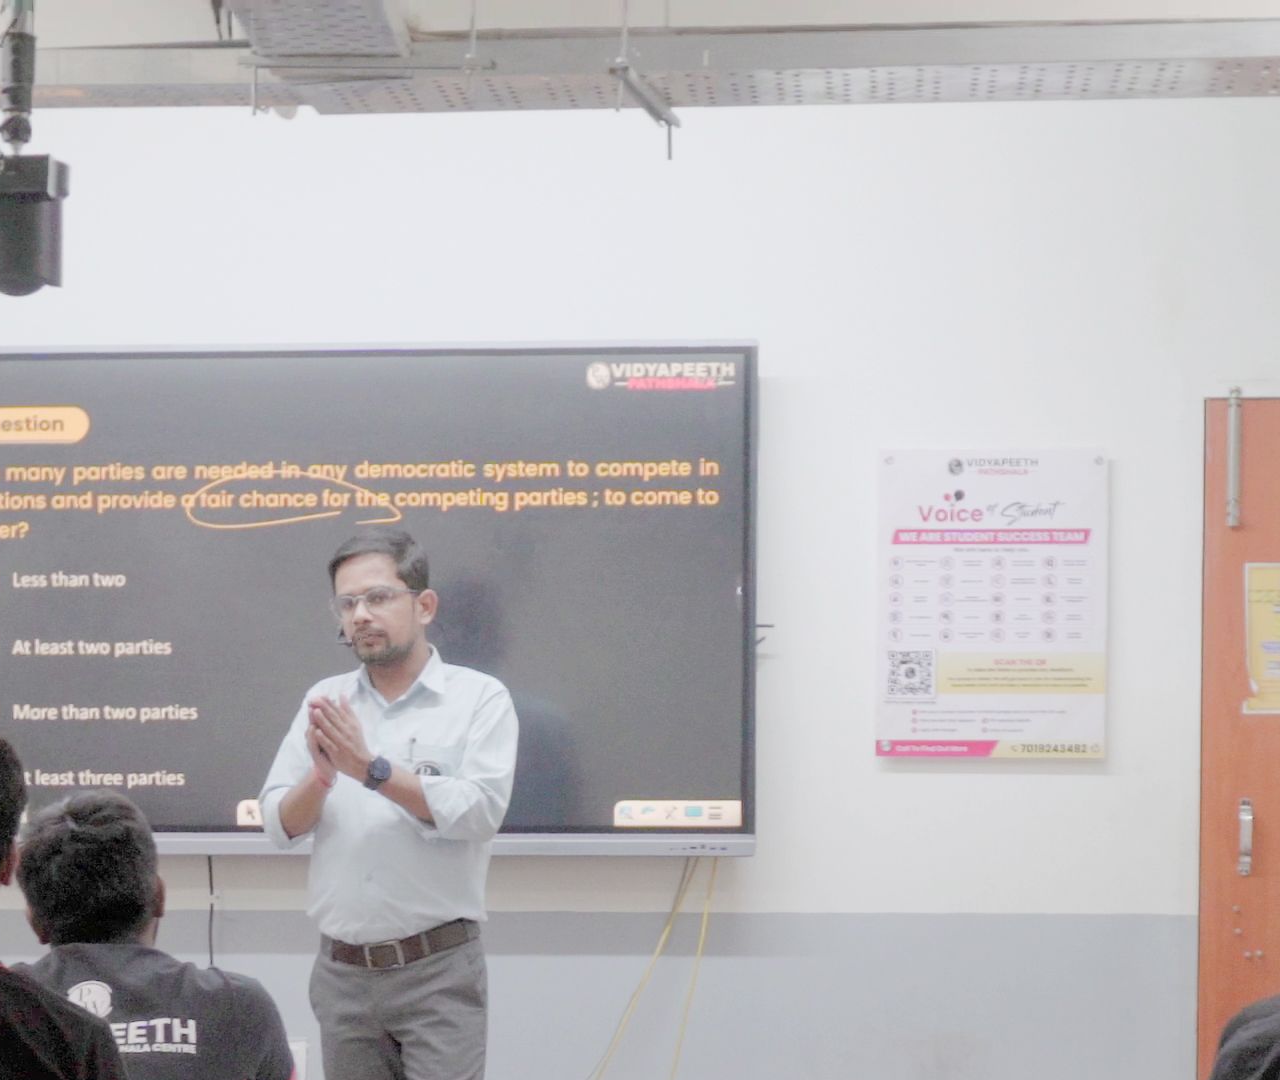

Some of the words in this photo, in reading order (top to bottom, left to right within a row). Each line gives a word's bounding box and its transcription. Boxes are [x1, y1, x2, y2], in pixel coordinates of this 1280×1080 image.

[610, 361, 736, 378] VIDYAPEETH
[5, 466, 66, 486] many
[73, 463, 145, 486] parties
[151, 464, 187, 480] are
[194, 461, 273, 479] needed
[281, 461, 300, 478] in
[307, 463, 347, 484] any
[354, 460, 475, 478] democratic
[483, 460, 560, 482] system
[567, 460, 589, 477] to
[595, 461, 692, 481] compete
[699, 458, 719, 476] in
[966, 457, 1039, 468] VIDYAPEETH
[50, 491, 92, 509] and
[96, 491, 176, 514] provide
[200, 490, 234, 508] fair
[239, 490, 317, 508] chance
[322, 489, 350, 507] for
[355, 489, 389, 507] the
[394, 488, 509, 512] competing
[514, 487, 588, 511] parties
[604, 489, 625, 506] to
[631, 490, 692, 506] come
[697, 488, 719, 506] to
[918, 503, 984, 523] Voice
[12, 571, 47, 588] Less
[51, 571, 89, 587] than
[93, 572, 126, 588] two
[11, 640, 30, 655] At
[34, 638, 74, 655] least
[78, 640, 111, 655] two
[114, 639, 172, 658] parties
[12, 704, 58, 721] More
[61, 702, 100, 720] than
[103, 705, 136, 720] two
[139, 703, 198, 723] parties
[35, 769, 74, 785] least
[78, 769, 123, 785] three
[127, 770, 185, 788] parties
